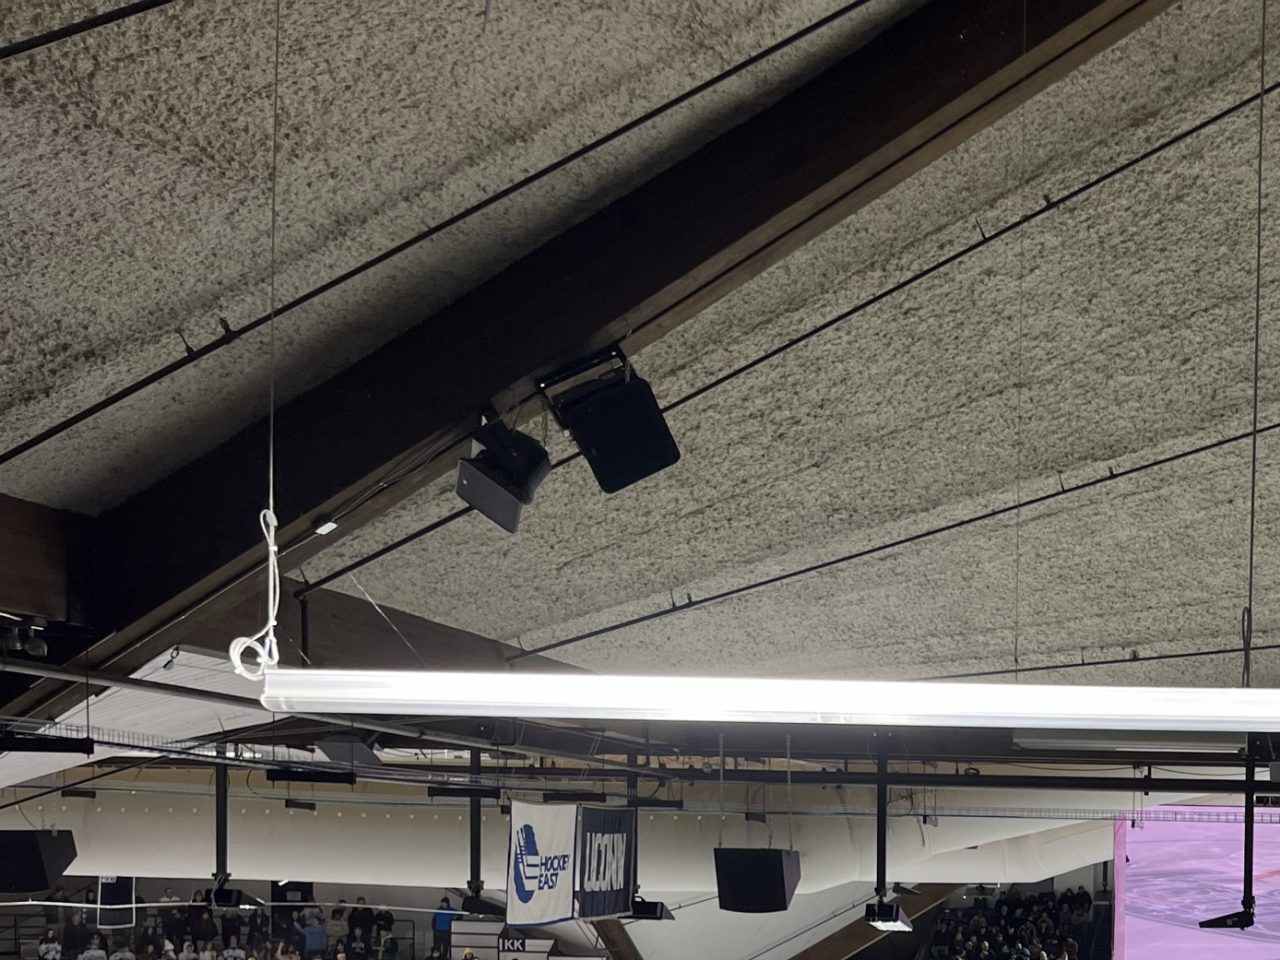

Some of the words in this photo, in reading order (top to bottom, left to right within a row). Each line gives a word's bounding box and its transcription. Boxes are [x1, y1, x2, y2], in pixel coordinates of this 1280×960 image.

[538, 854, 572, 873] HOCKEY
[583, 831, 627, 893] UCONN
[538, 872, 560, 890] EAST
[504, 939, 524, 951] KK
